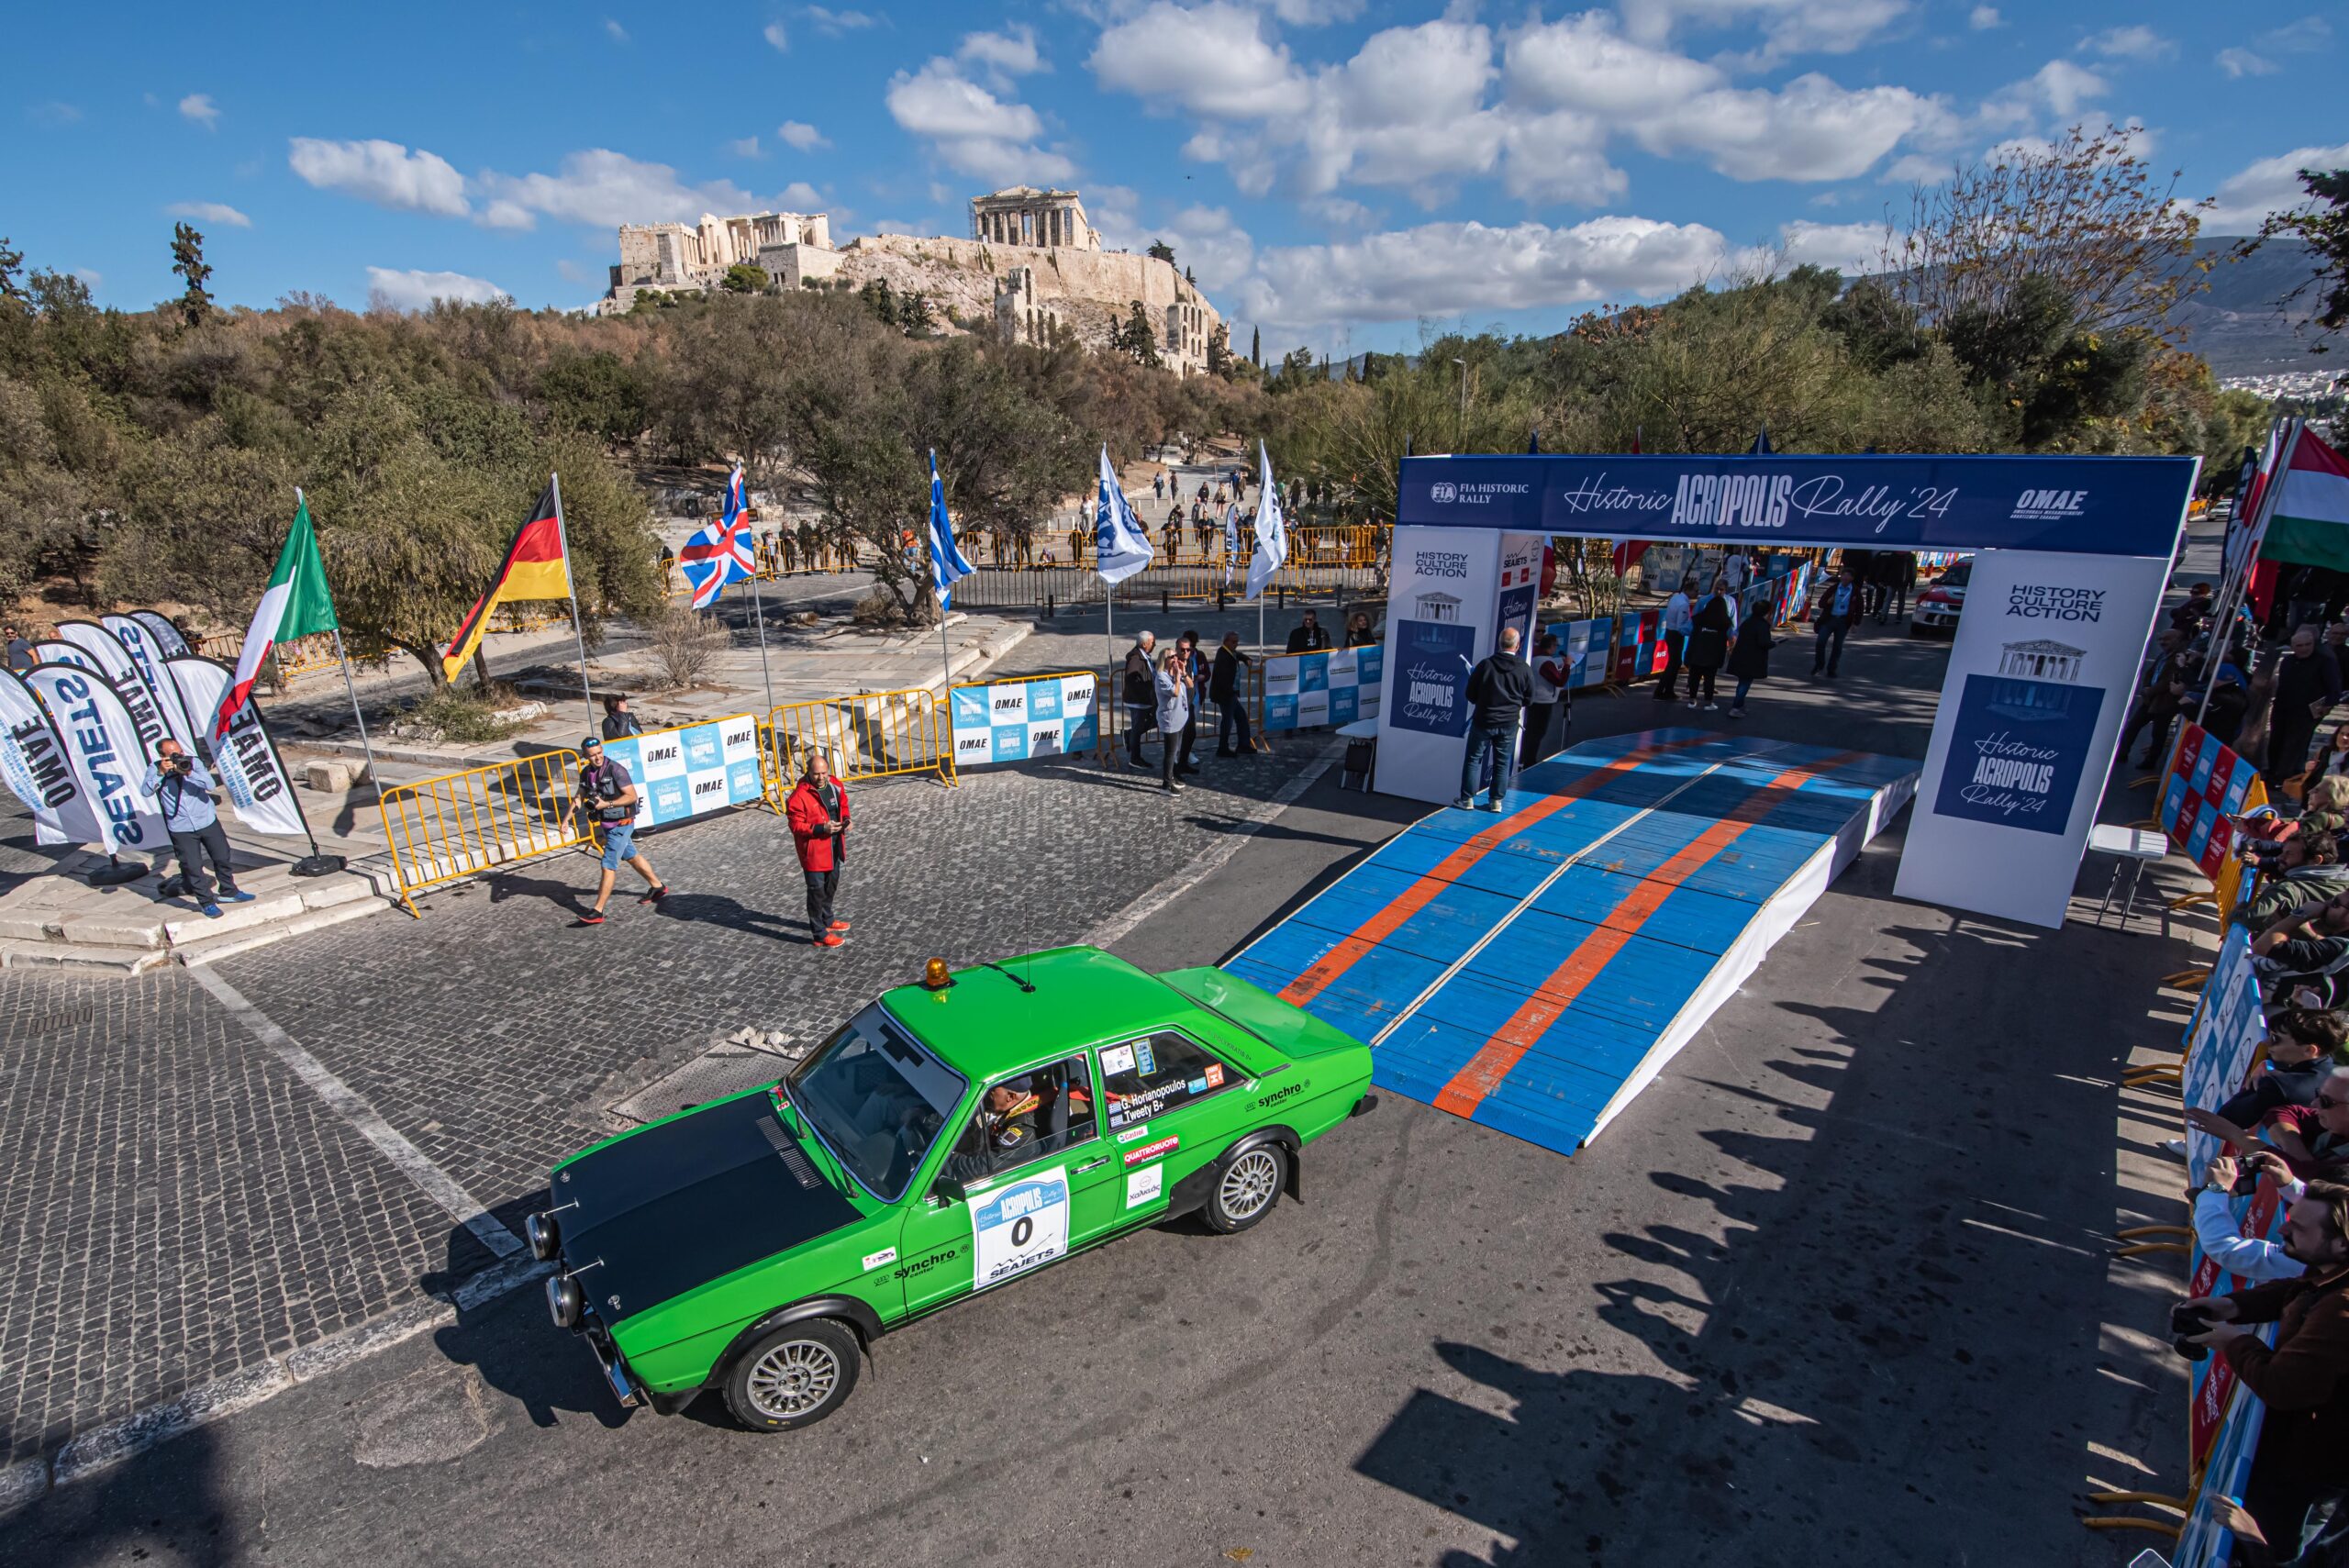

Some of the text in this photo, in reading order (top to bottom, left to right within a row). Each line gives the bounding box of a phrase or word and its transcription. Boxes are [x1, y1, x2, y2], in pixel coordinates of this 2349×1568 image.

[1459, 484, 1530, 494] FIA HISTORIC
[1458, 495, 1492, 504] RALLY
[1564, 472, 1673, 514] Historic
[1670, 474, 1793, 528] ACROPOLIS
[2016, 489, 2089, 510] OMAE
[1415, 559, 1467, 570] CULTURE
[1416, 551, 1468, 562] HISTORY
[1503, 556, 1528, 569] SEAJETS
[1414, 567, 1467, 578] ACTION
[2011, 584, 2107, 601] HISTORY
[2009, 596, 2103, 611] CULTURE
[2005, 606, 2101, 623] ACTION
[1406, 661, 1455, 683] Historic
[1067, 688, 1092, 702] OMAE
[1408, 681, 1454, 708] ACROPOLIS
[995, 698, 1023, 710] OMAE
[727, 730, 751, 746] OMAE
[1032, 729, 1060, 742] OMAE
[959, 738, 987, 751] OMAE
[1974, 731, 2059, 761] Historic
[647, 746, 677, 762] OMAE
[1972, 756, 2054, 794] ACROPOLIS
[695, 779, 723, 795] OMAE
[1120, 1097, 1131, 1110] G.
[1130, 1079, 1186, 1107] Horianopoulos
[1258, 1084, 1301, 1107] synchro
[1124, 1100, 1164, 1123] Tweety B+
[1125, 1129, 1144, 1140] Castrol
[1000, 1186, 1043, 1221] ACROPOLIS
[1011, 1216, 1033, 1248] 0
[894, 1250, 956, 1279] synchro
[989, 1248, 1054, 1279] SEAJETS
[909, 1266, 934, 1279] center
